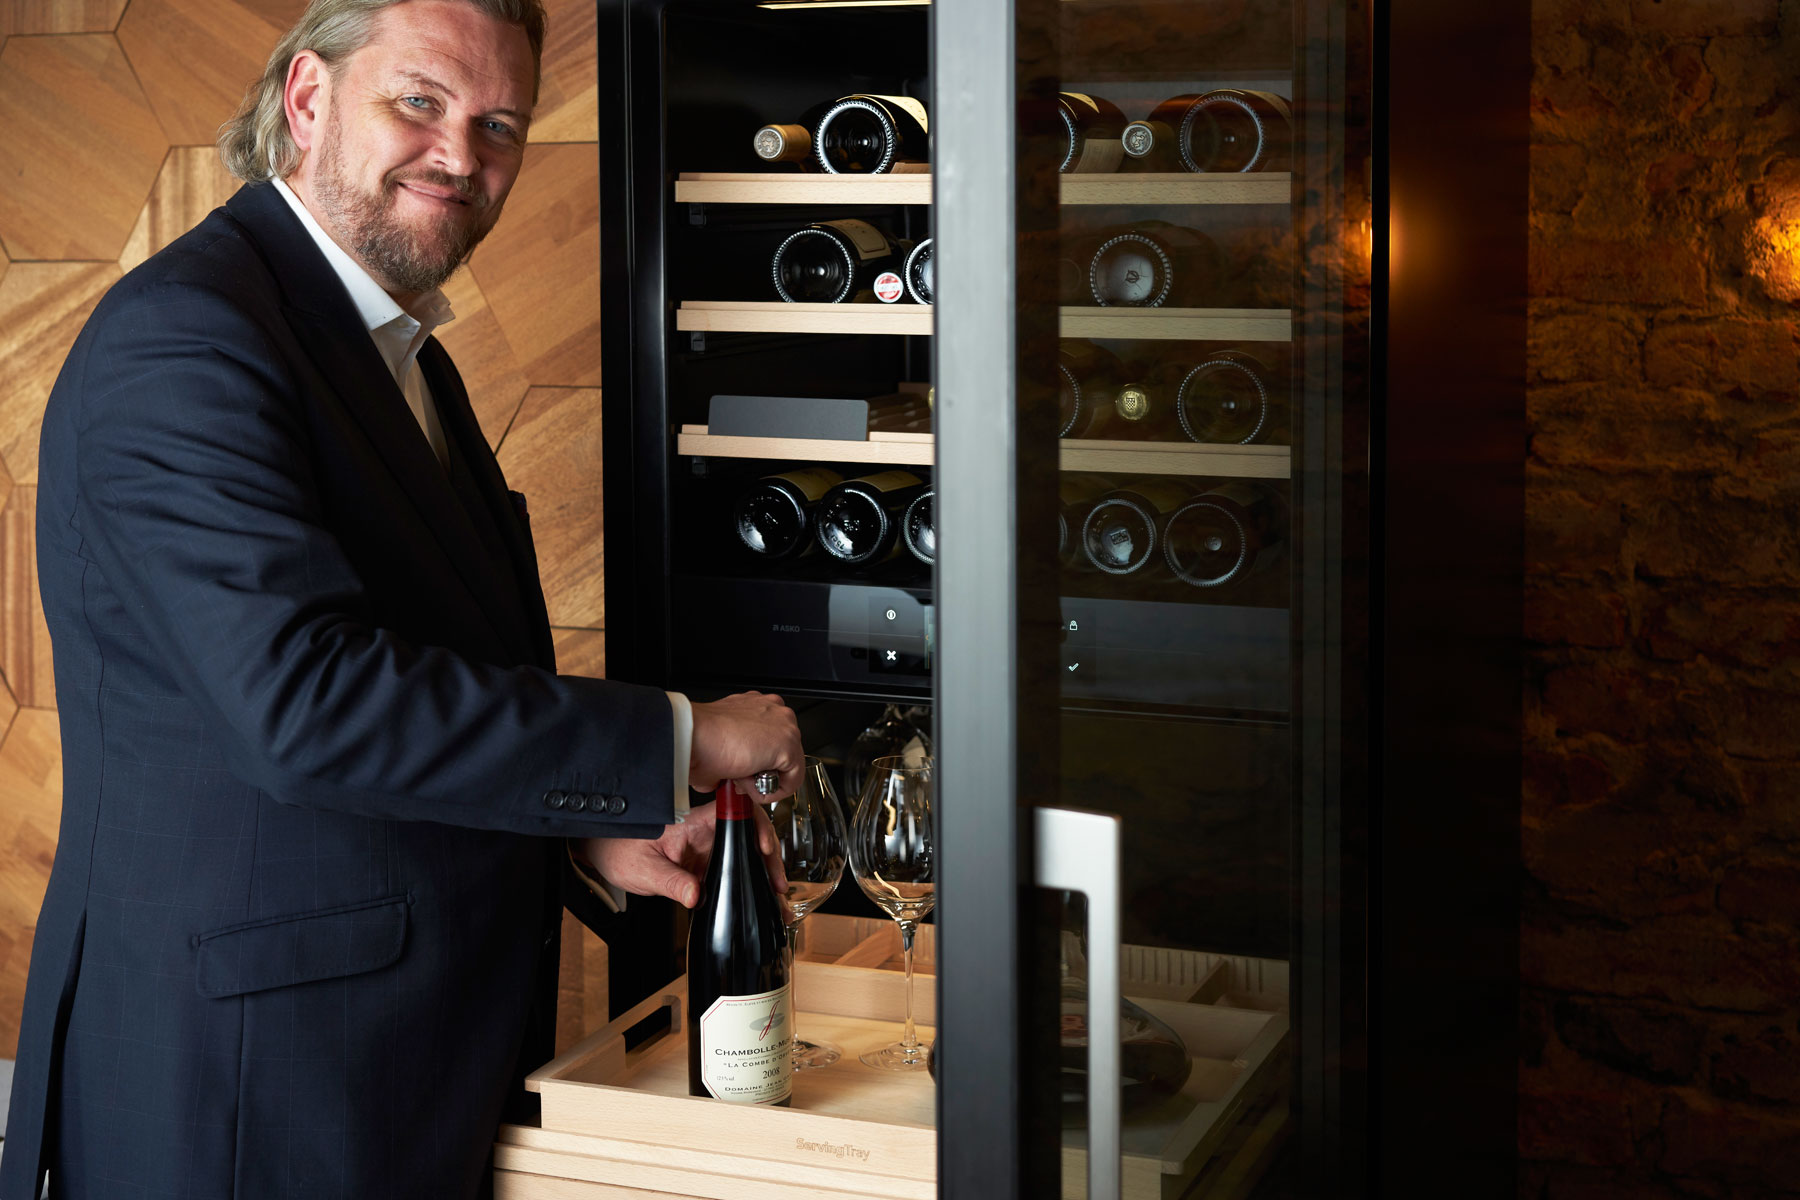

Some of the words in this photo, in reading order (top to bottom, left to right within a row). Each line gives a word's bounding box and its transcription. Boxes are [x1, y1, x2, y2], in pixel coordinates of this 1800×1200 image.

[780, 624, 801, 633] ASKO
[715, 1038, 790, 1056] CHAMBOLLE-M
[762, 1066, 781, 1080] 2008
[796, 1137, 871, 1162] ServingTray
